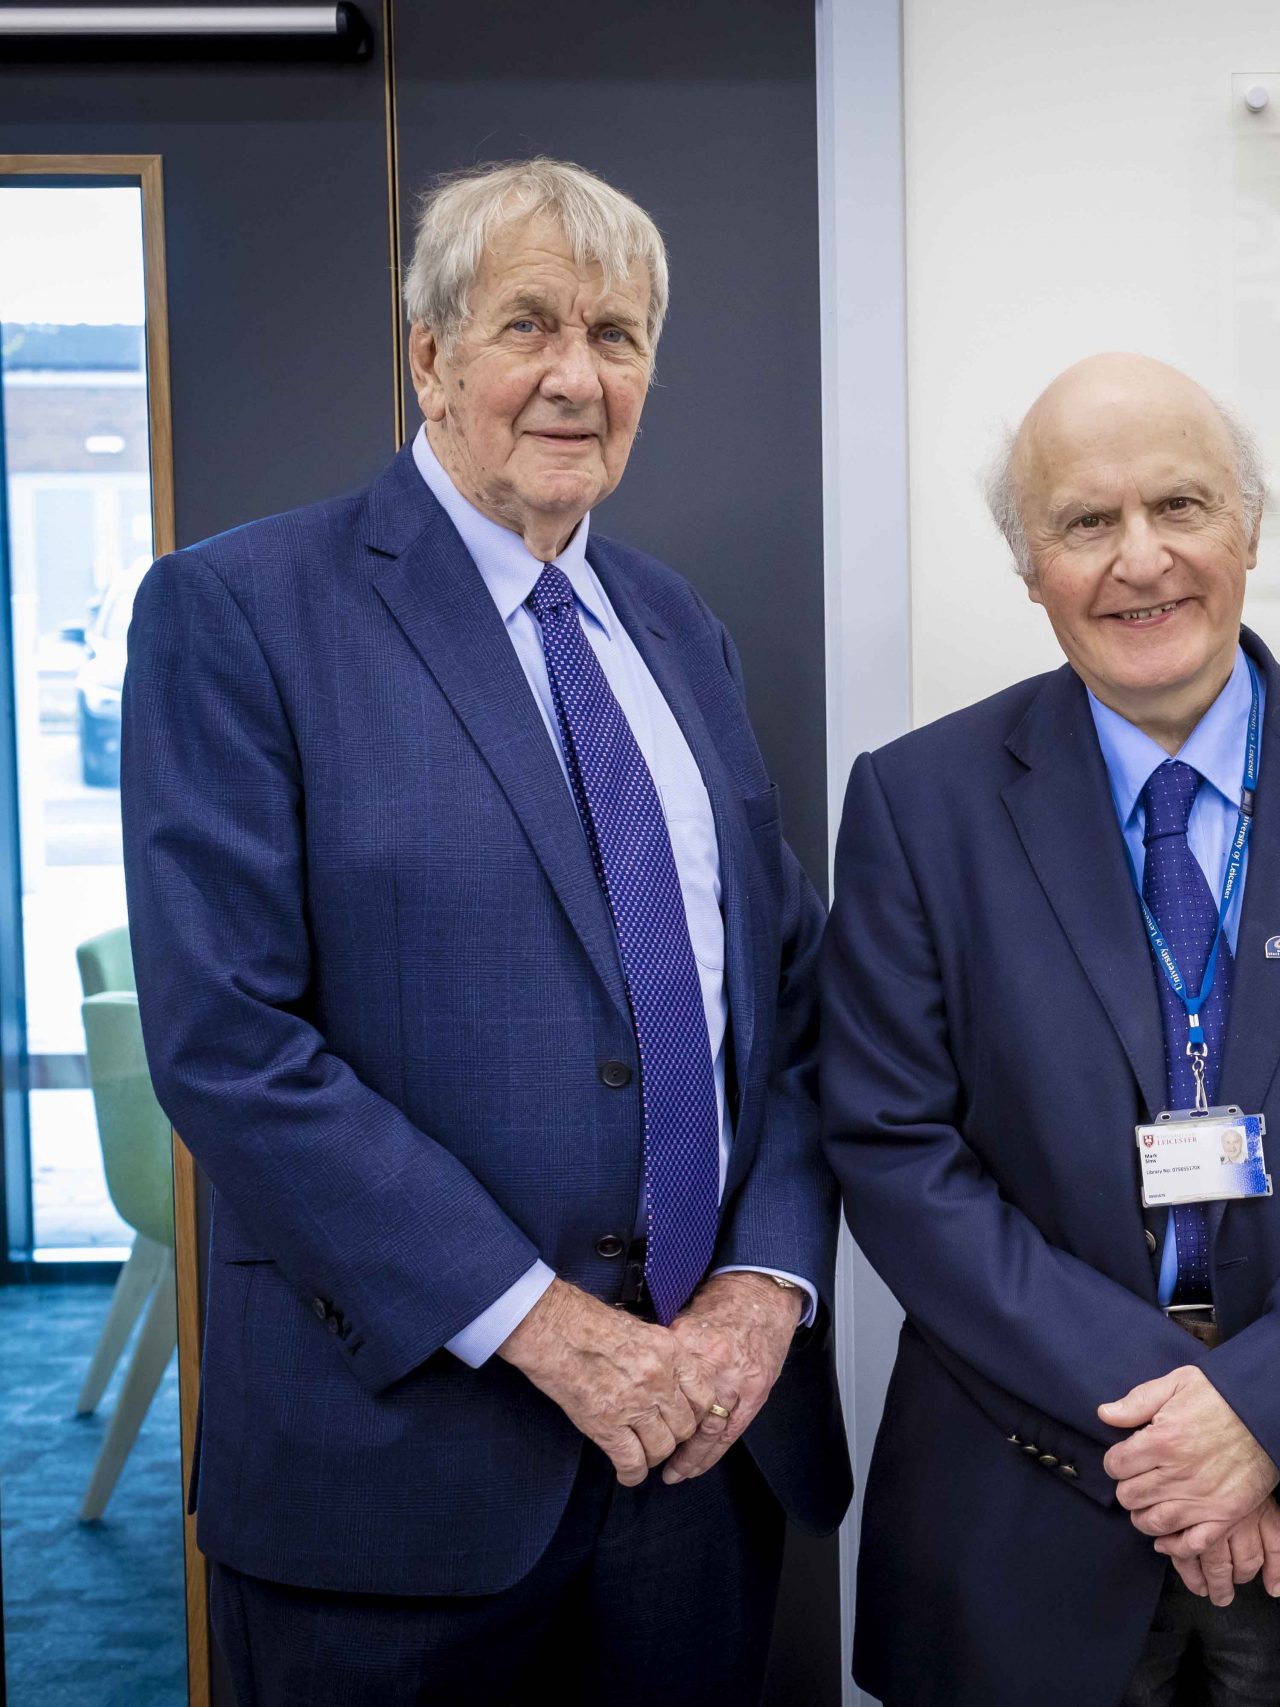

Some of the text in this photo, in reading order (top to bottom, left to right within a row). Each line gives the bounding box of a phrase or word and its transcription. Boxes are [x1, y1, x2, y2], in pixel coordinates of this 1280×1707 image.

[1223, 862, 1240, 899] Leicester
[1155, 938, 1163, 947] of
[1160, 948, 1183, 991] University
